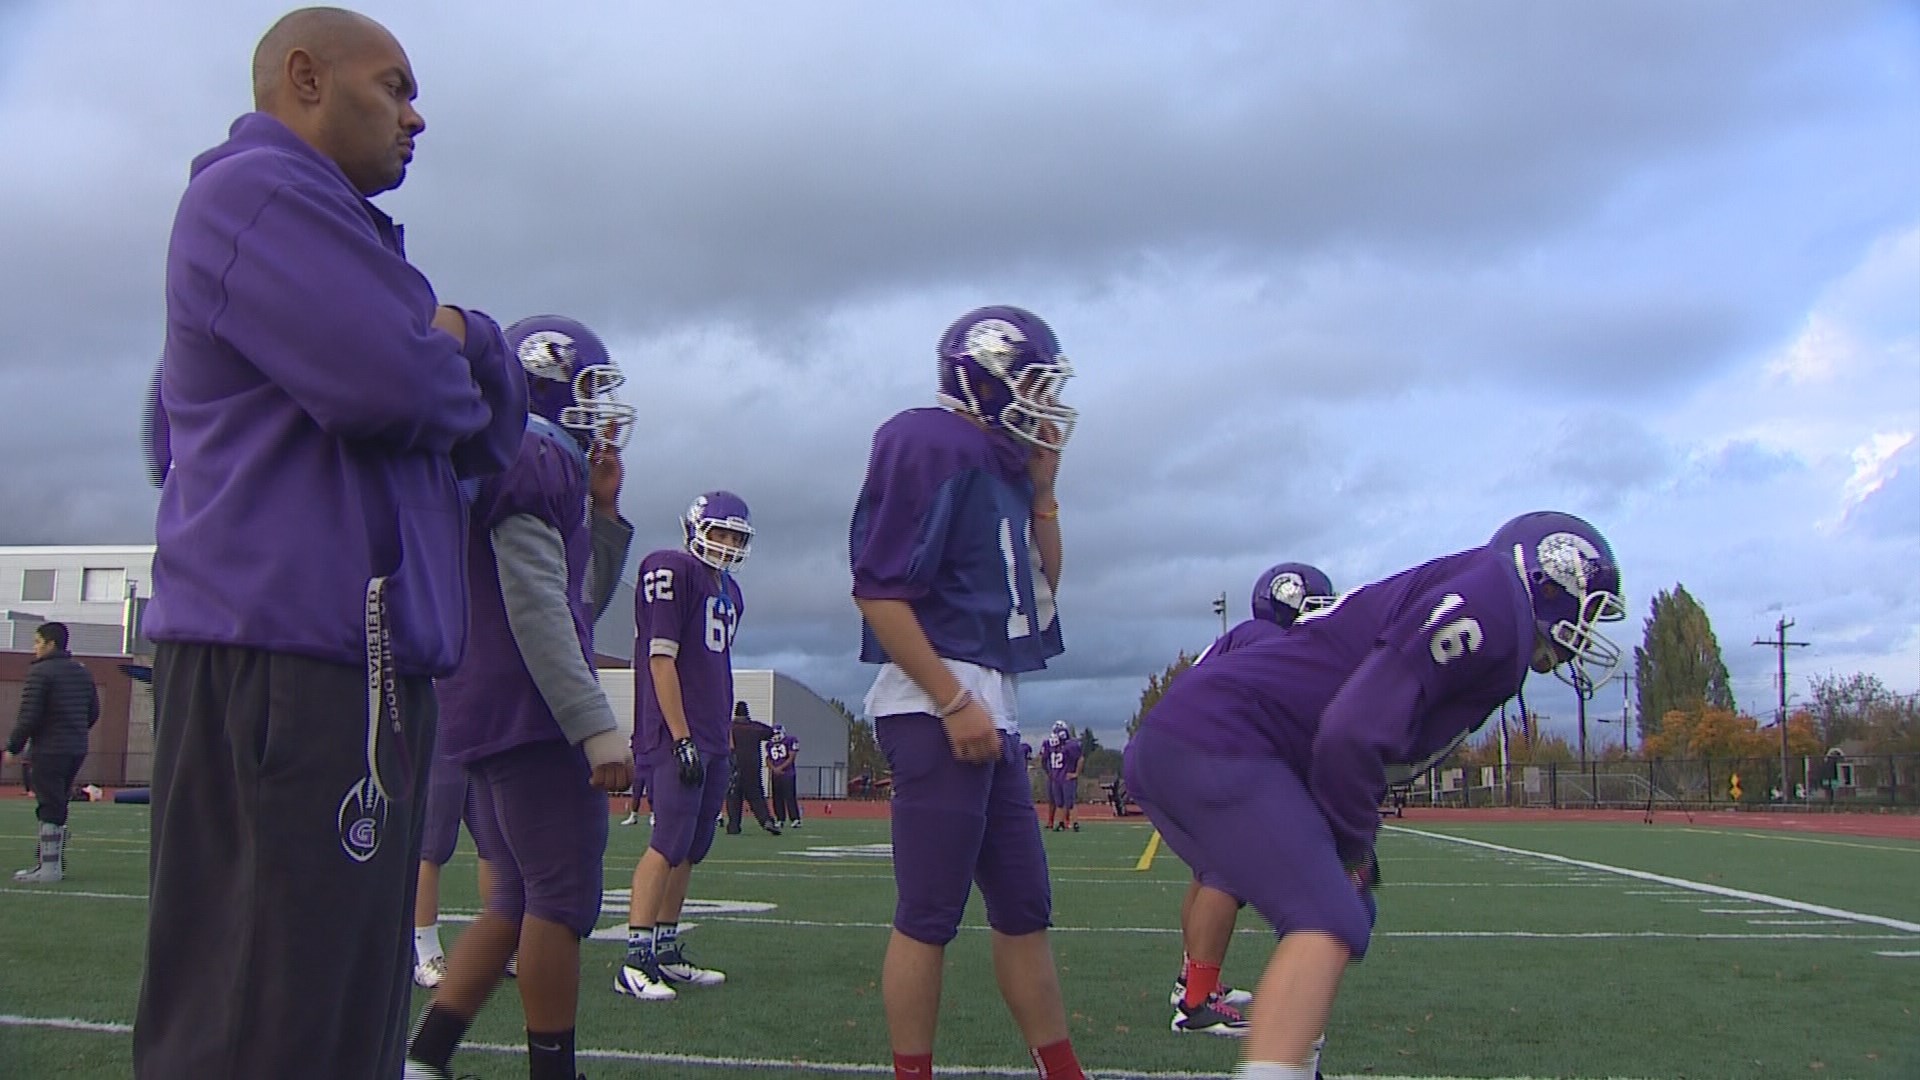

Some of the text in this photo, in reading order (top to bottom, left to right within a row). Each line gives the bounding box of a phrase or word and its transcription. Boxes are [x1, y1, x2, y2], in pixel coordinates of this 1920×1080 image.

[1417, 593, 1484, 665] 16
[770, 743, 787, 760] 63
[1050, 751, 1064, 769] 12
